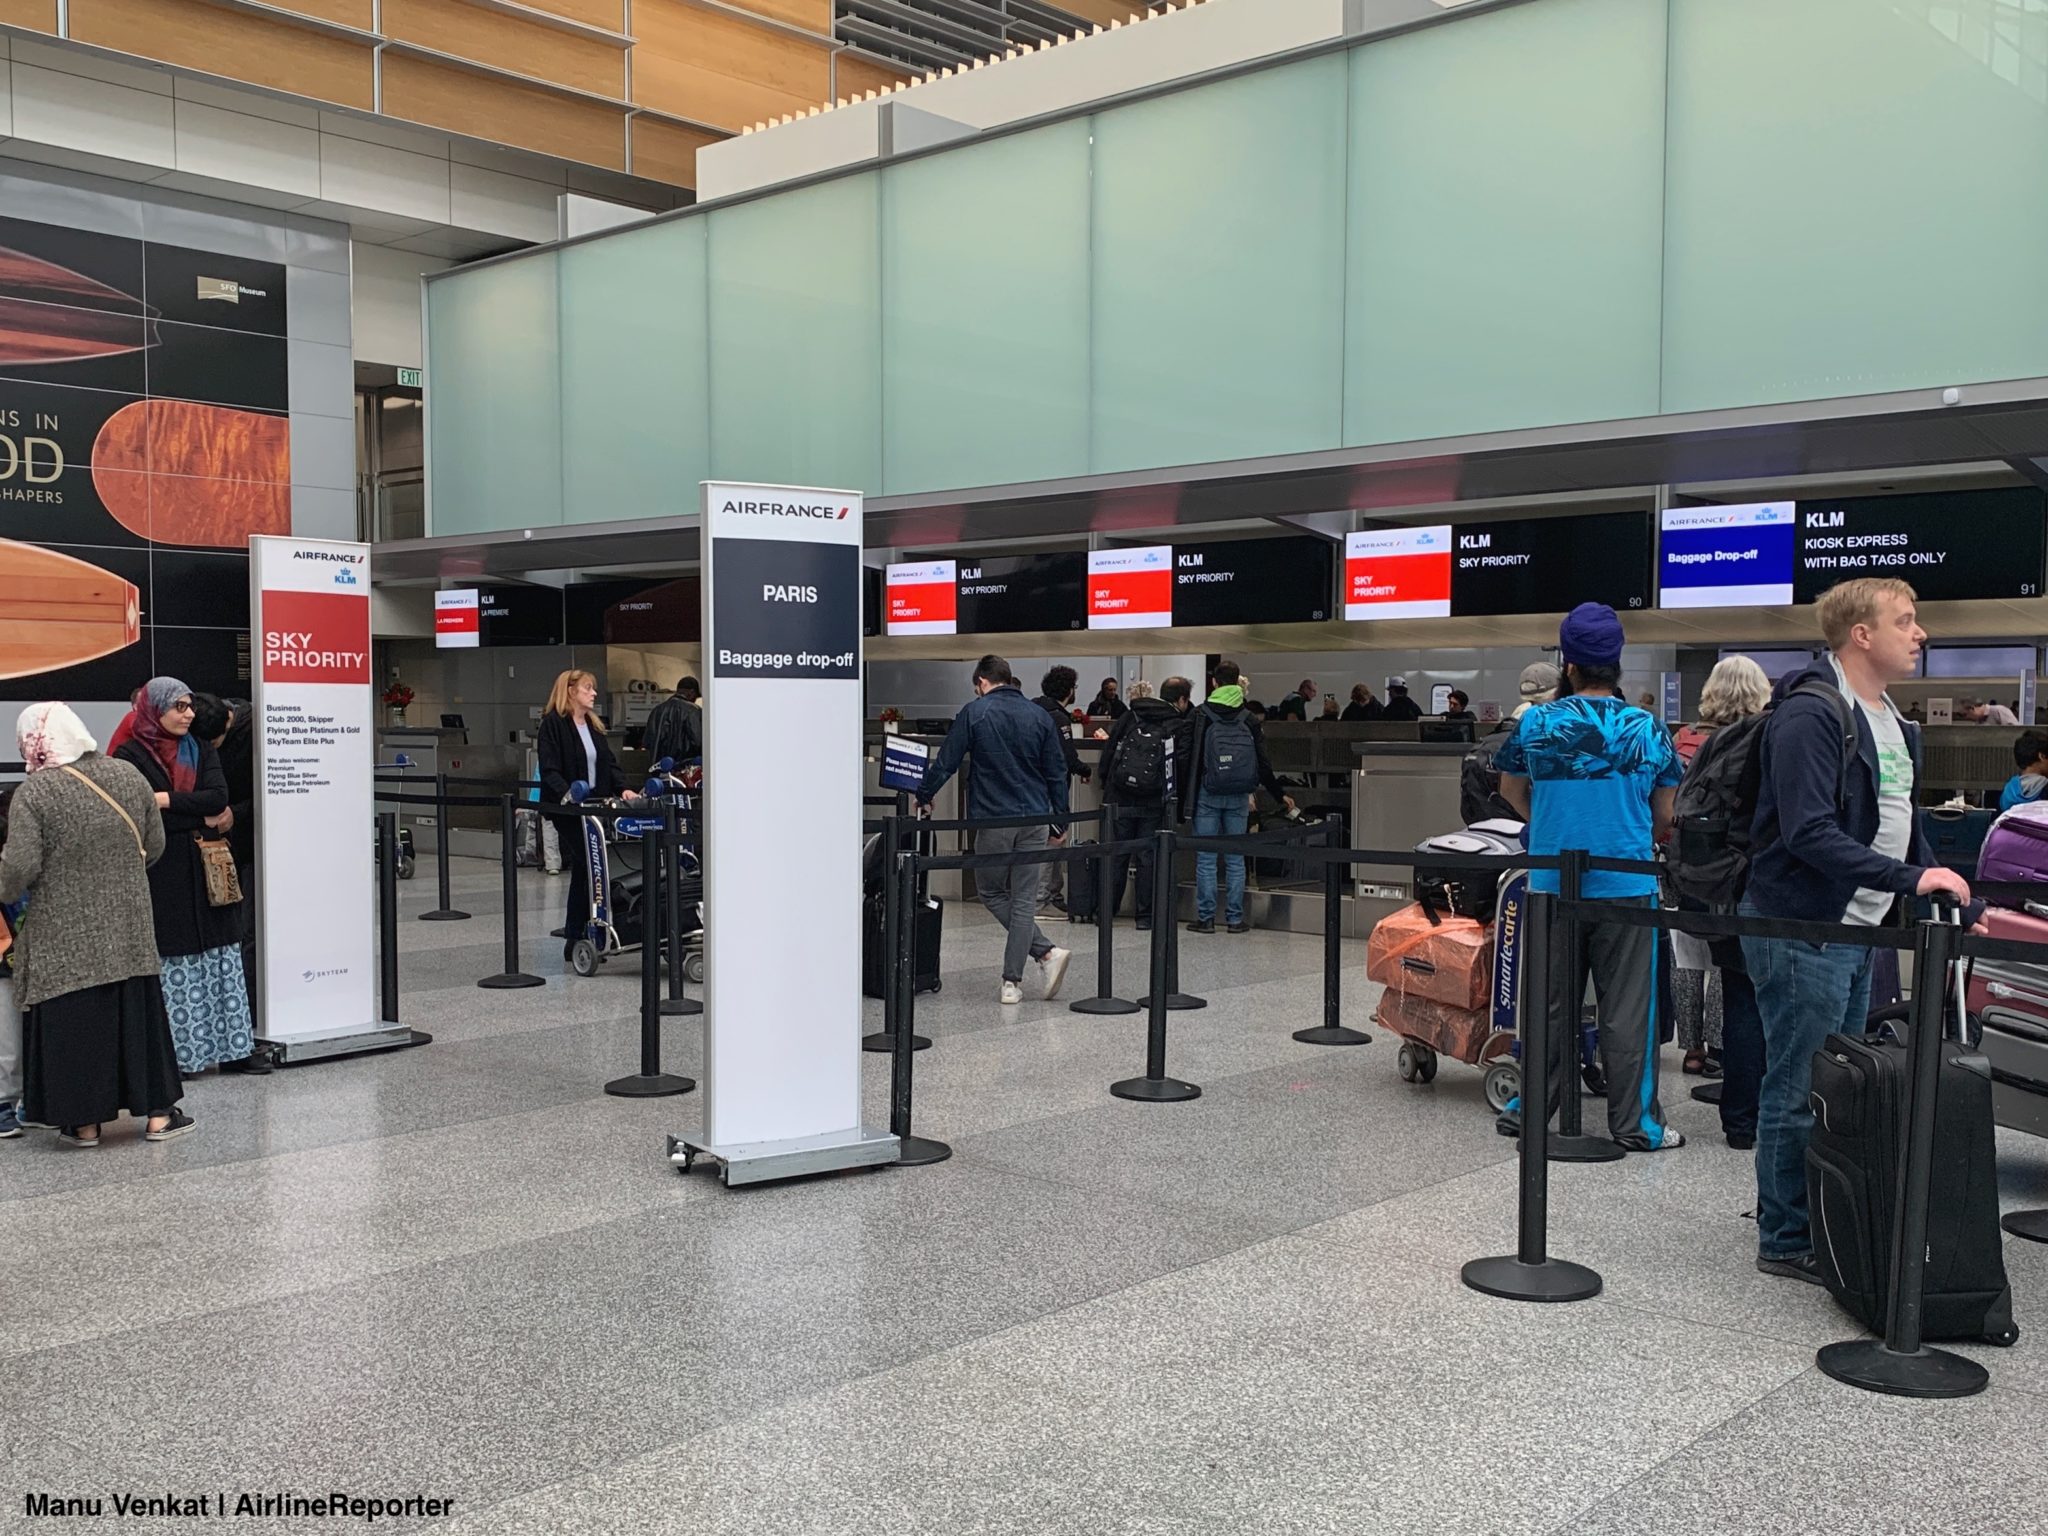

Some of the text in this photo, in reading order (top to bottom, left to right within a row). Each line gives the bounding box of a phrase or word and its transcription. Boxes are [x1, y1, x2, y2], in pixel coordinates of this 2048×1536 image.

[220, 283, 266, 297] SFO Museum
[401, 370, 420, 386] EXIT
[36, 413, 58, 431] IN
[0, 488, 63, 504] HAPERS
[722, 501, 834, 519] AIRFRANCE
[1669, 517, 1726, 525] AIRFRANCE
[1806, 511, 1844, 528] KLM
[1460, 535, 1491, 549] KLM
[1805, 534, 1908, 550] KIOSK EXPRESS
[293, 551, 356, 563] AIRFRANCE
[1179, 554, 1203, 566] KLM
[1460, 555, 1531, 568] SKY PRIORITY
[1668, 549, 1758, 564] Baggage Drop-off
[1805, 552, 1946, 569] WITH BAG TAGS ONLY
[961, 568, 982, 579] KLM
[1178, 572, 1234, 584] SKY PRIORITY
[334, 575, 356, 584] KLM
[1354, 576, 1373, 585] SKY
[764, 584, 818, 603] PARIS
[961, 585, 1007, 595] SKY PRIORITY
[1095, 590, 1110, 598] SKY
[1354, 586, 1397, 596] PRIORITY
[2021, 584, 2036, 595] 91
[482, 596, 494, 604] KLM
[893, 600, 905, 608] SKY
[1095, 599, 1129, 608] PRIORITY
[1629, 597, 1642, 607] 90
[620, 602, 653, 611] SKY PRIORITY
[893, 608, 921, 616] PRIORITY
[1313, 611, 1323, 619] 89
[266, 631, 312, 649] SKY
[266, 650, 363, 668] PRIORITY
[720, 650, 854, 669] Baggage drop-off
[266, 704, 301, 712] Business
[308, 716, 334, 724] Skipper
[267, 727, 290, 735] Flying
[267, 738, 301, 746] SkyTeam
[317, 968, 348, 977] SKYTEAM
